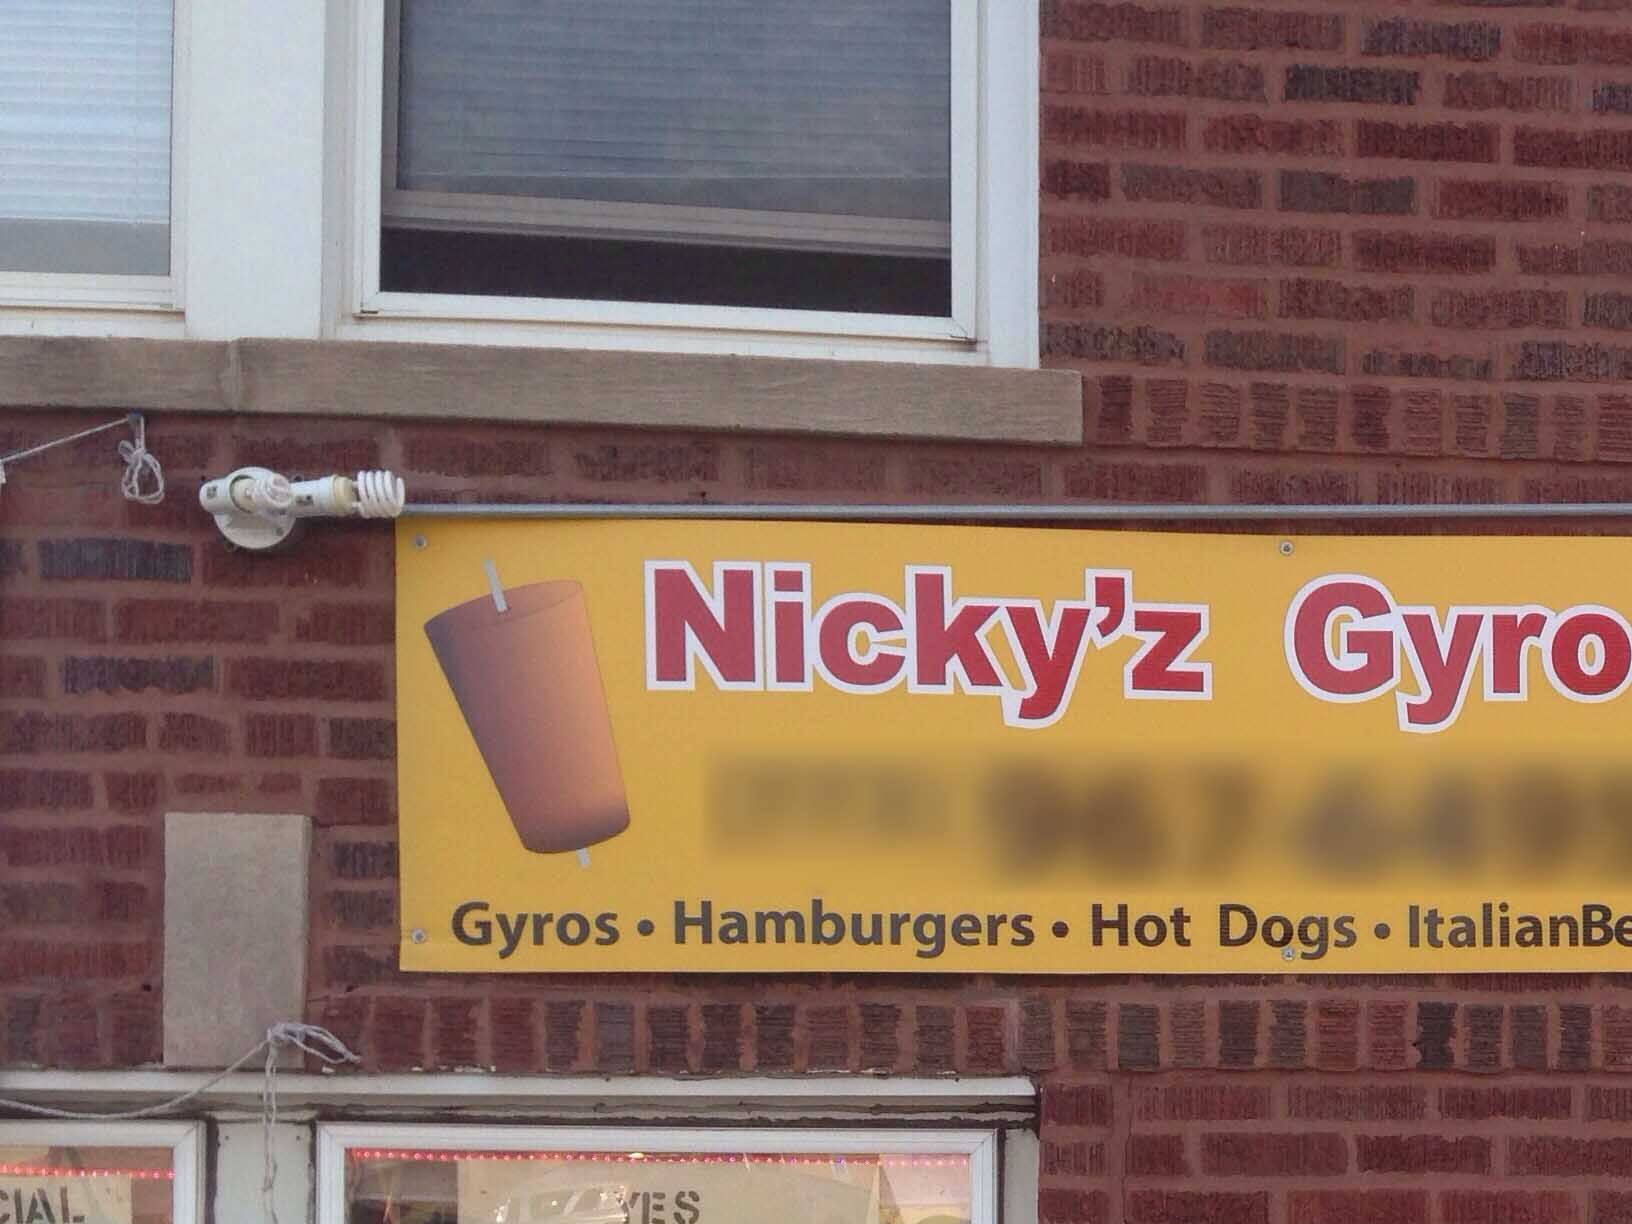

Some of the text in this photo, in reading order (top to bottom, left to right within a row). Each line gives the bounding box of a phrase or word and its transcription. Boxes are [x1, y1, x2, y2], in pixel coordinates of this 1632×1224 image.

[645, 560, 1212, 728] Nicky'z
[452, 902, 620, 958] Gyros
[674, 900, 1034, 958] Hamburgers
[1091, 903, 1191, 946] Hot
[1219, 904, 1357, 960] Dogs
